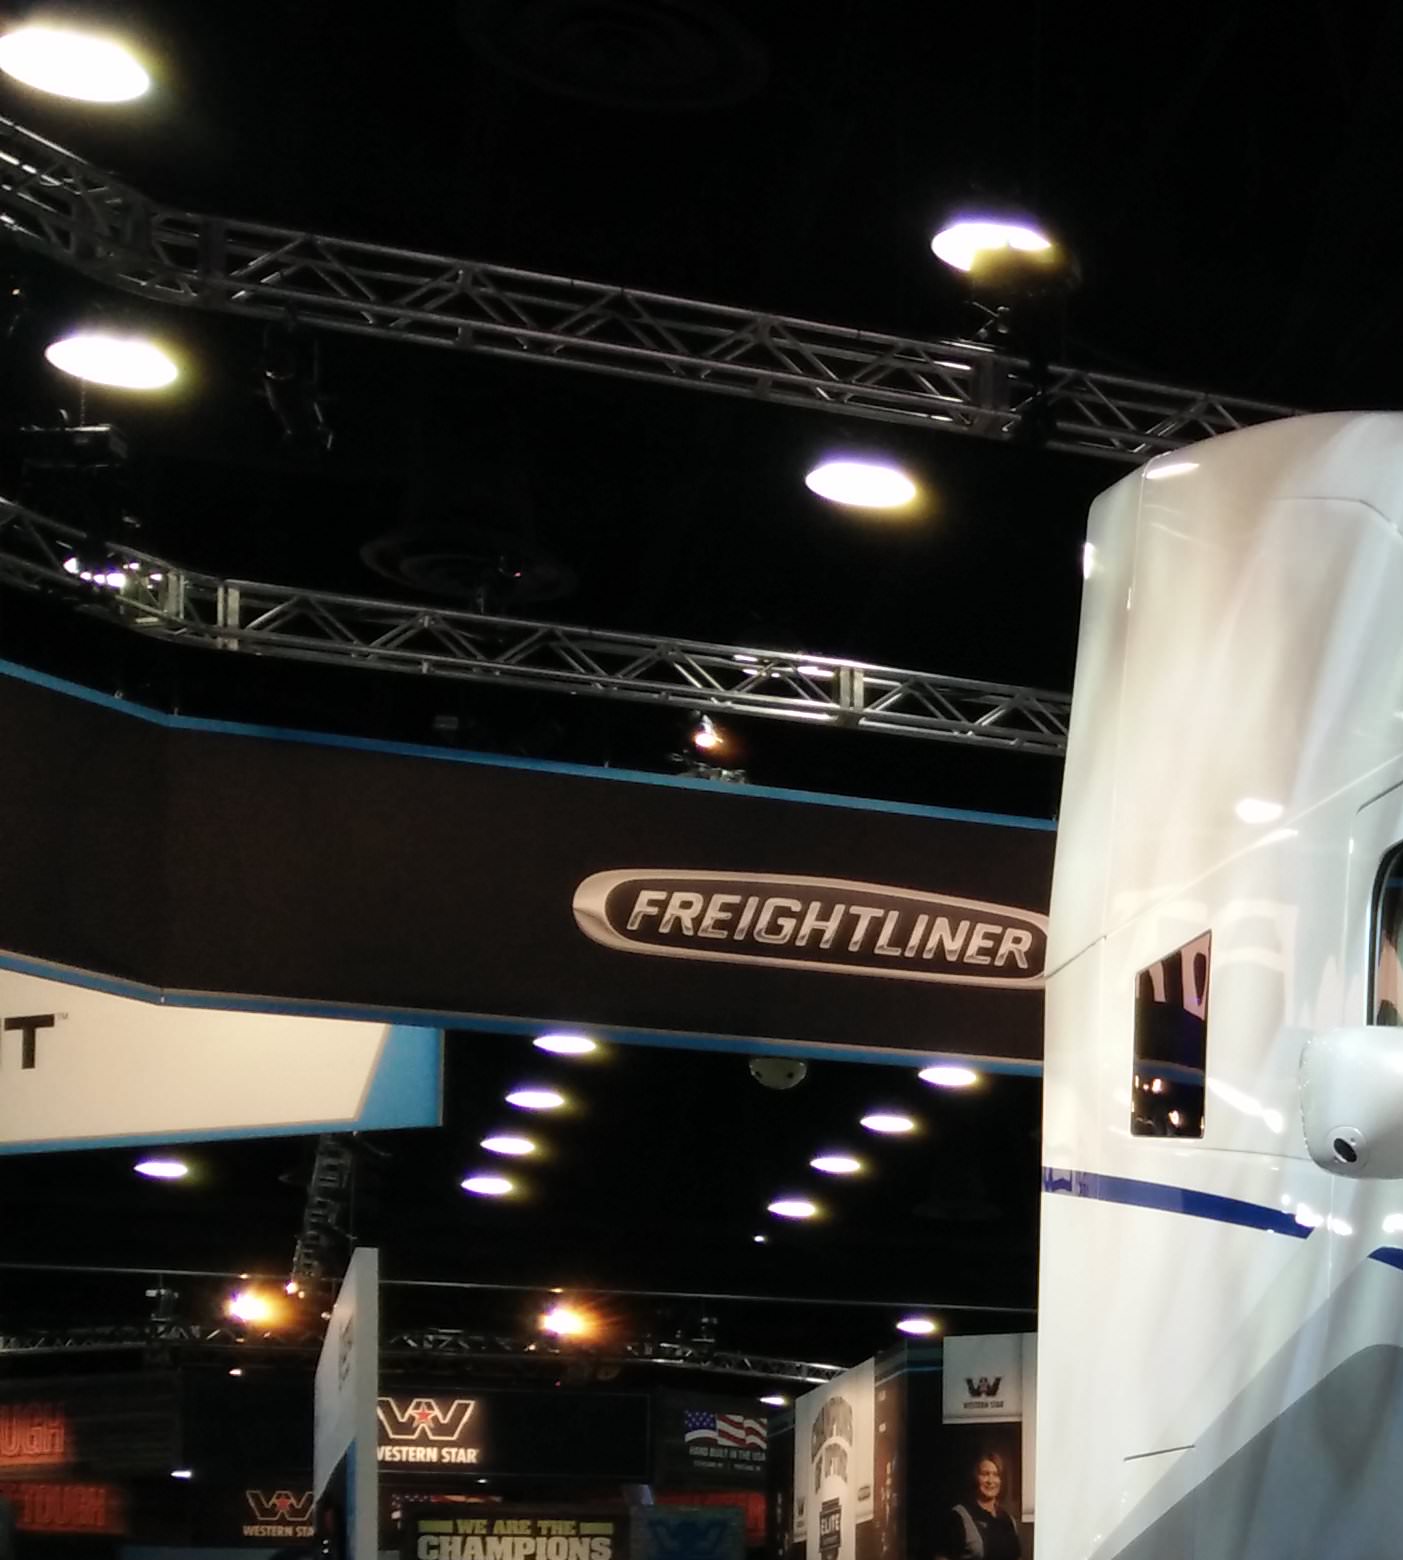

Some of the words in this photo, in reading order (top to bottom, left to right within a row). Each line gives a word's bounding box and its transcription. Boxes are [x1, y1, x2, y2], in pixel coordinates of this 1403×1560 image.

[626, 889, 1033, 969] FREIGHTLINER
[441, 1447, 477, 1464] STAR
[243, 1526, 293, 1537] WESTERN
[295, 1526, 314, 1537] STA
[456, 1520, 487, 1534] WE
[493, 1520, 531, 1534] ARE
[538, 1520, 577, 1534] THE
